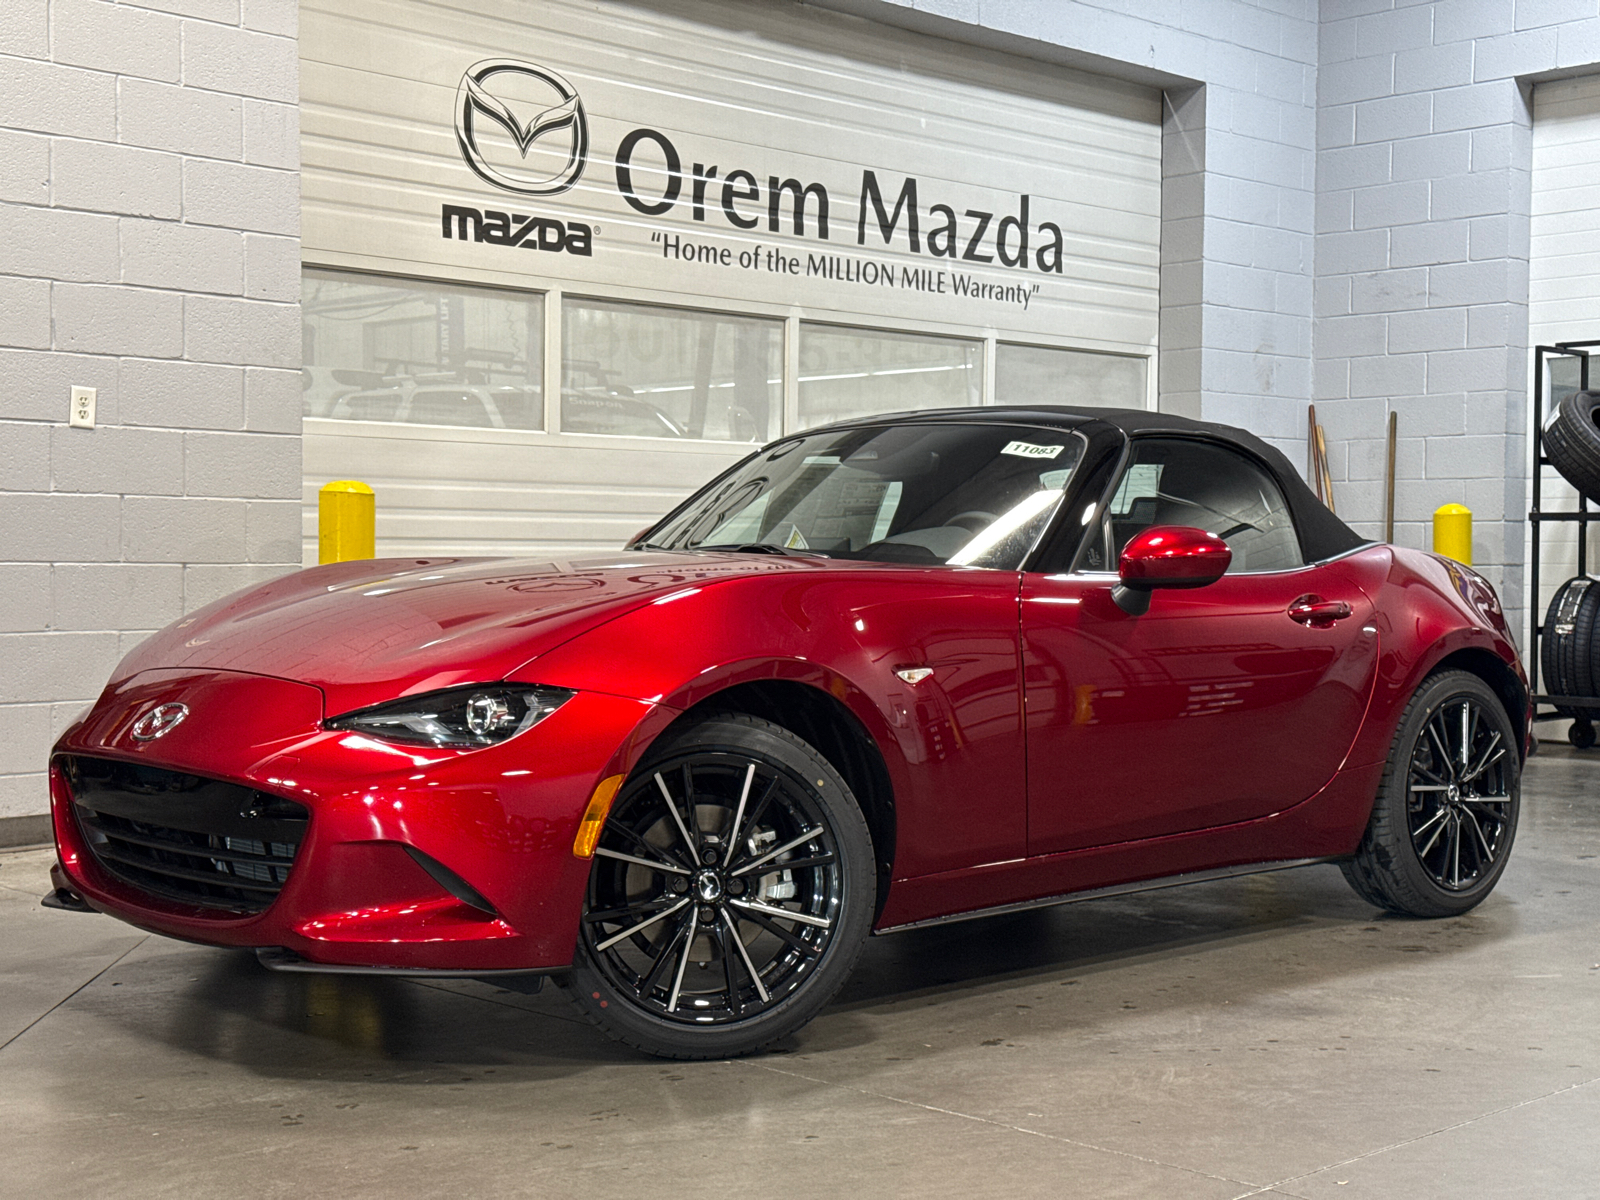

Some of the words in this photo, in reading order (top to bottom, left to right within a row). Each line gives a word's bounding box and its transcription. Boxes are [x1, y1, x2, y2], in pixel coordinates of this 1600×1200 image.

[615, 129, 829, 241] Orem
[856, 170, 1064, 274] Mazda
[442, 204, 592, 257] mazda
[739, 245, 762, 270] of
[766, 247, 801, 276] the
[806, 253, 895, 289] MILLION
[901, 266, 946, 294] MILE
[1012, 443, 1057, 455] 11083
